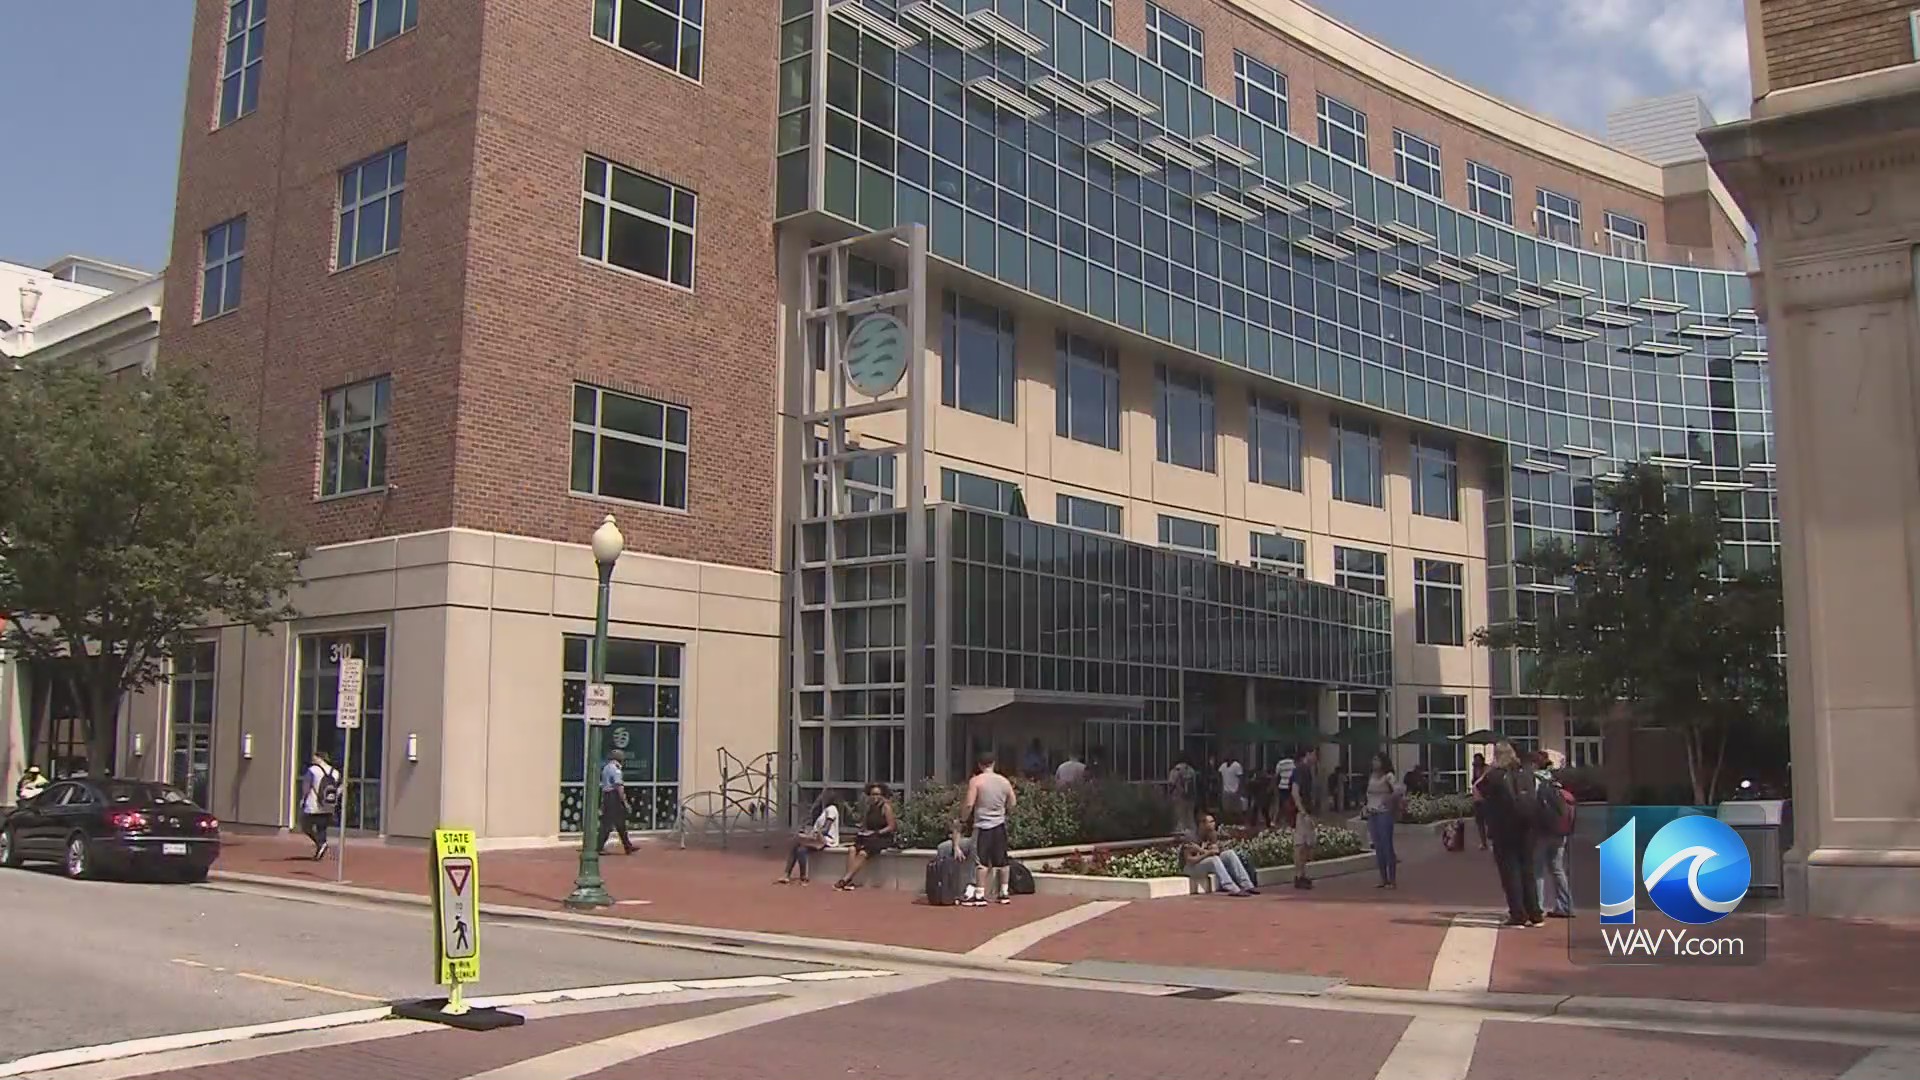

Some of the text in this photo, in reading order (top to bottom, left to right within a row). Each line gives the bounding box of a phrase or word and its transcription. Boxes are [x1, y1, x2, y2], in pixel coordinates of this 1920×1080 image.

[330, 643, 351, 662] 310
[593, 688, 605, 697] NO
[443, 833, 470, 844] STATE
[447, 845, 467, 855] LAW
